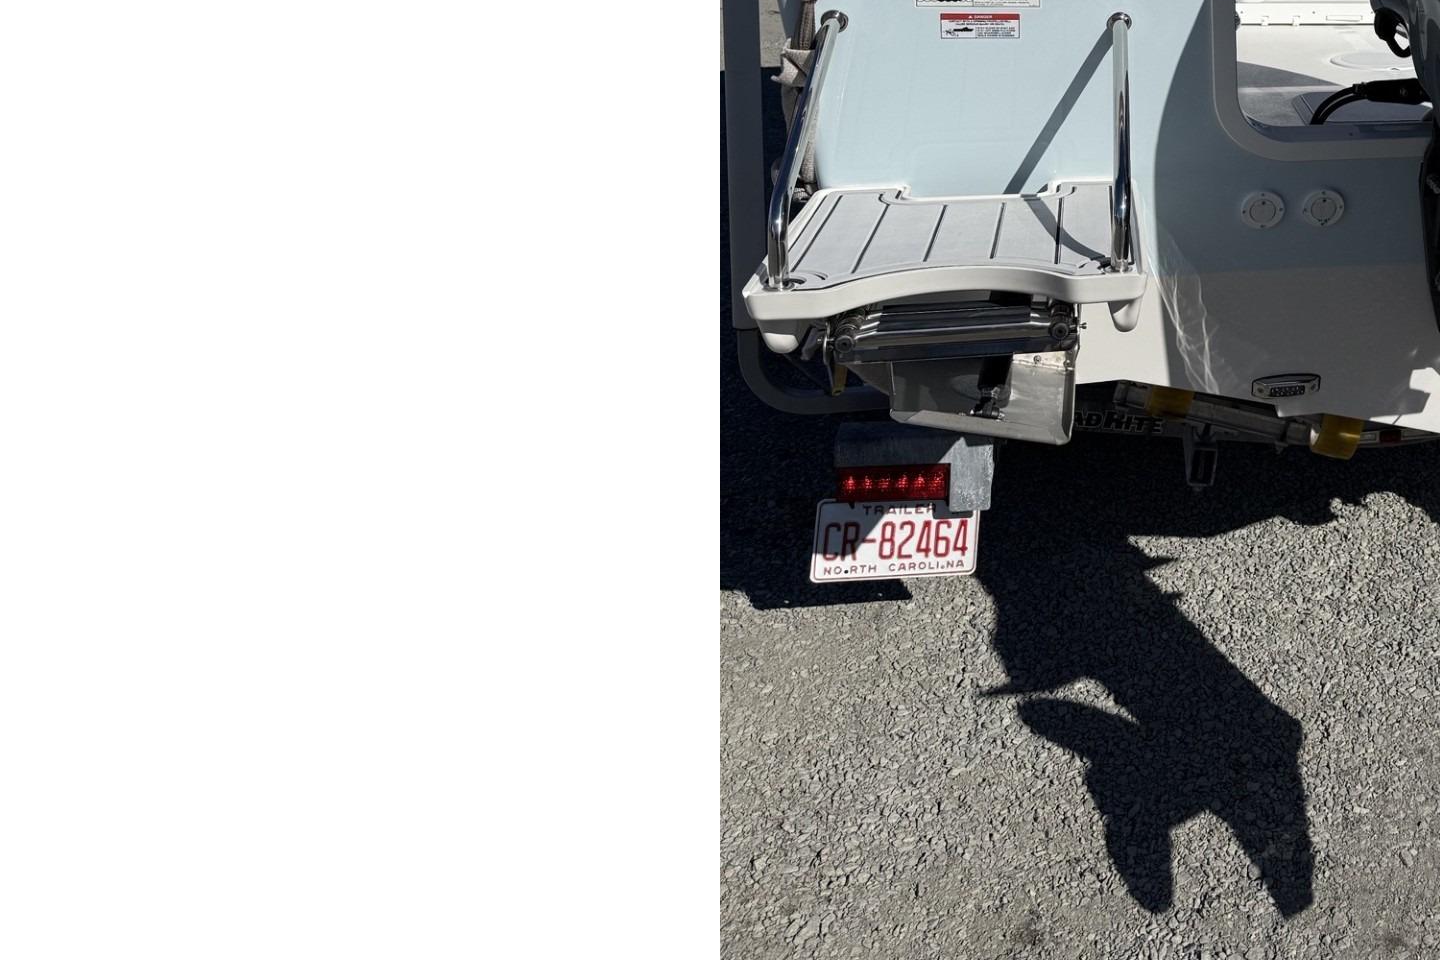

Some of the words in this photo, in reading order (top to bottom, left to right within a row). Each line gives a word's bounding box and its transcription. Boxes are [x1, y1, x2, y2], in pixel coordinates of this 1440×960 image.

[862, 504, 936, 516] TRAILER
[822, 519, 969, 561] CR-82464
[824, 564, 877, 575] NORTH
[888, 559, 965, 572] CAROLINA
